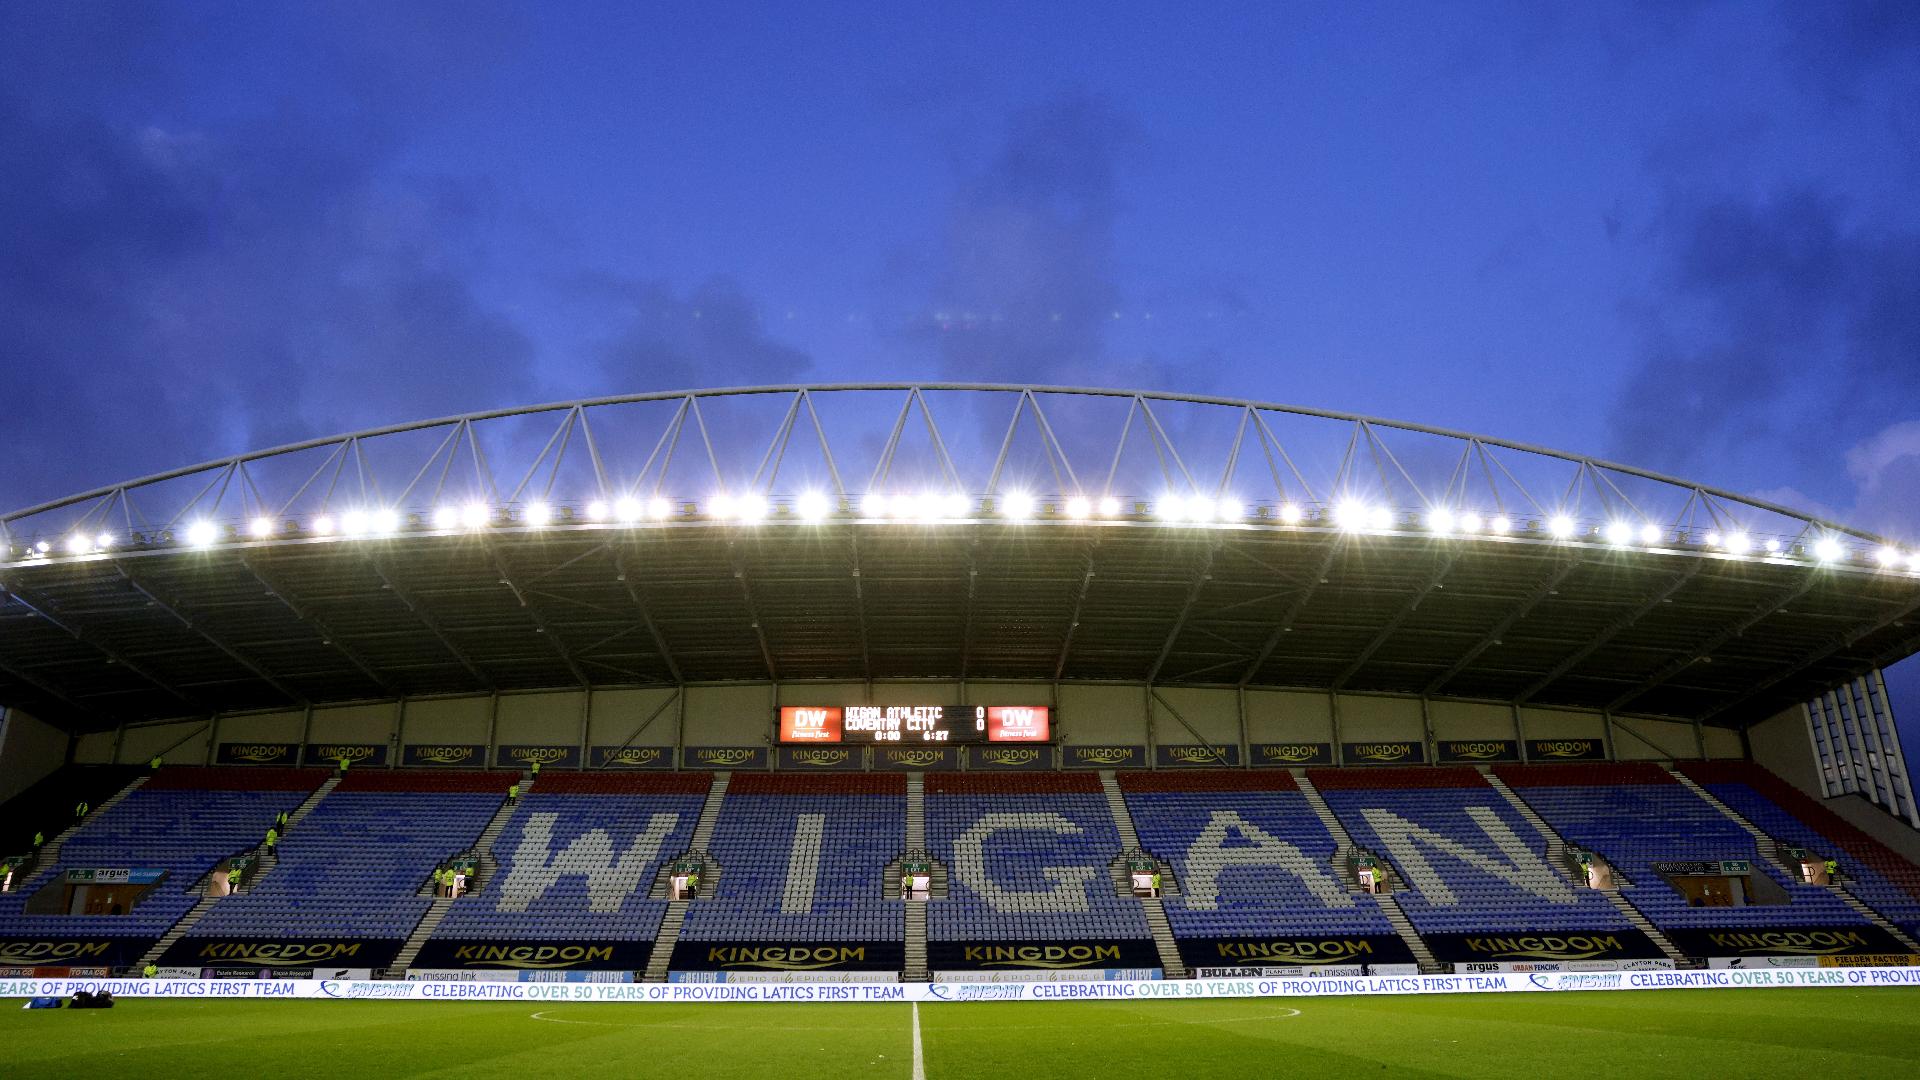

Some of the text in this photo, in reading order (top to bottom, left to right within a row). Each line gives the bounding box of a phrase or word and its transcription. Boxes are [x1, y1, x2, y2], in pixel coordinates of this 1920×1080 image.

[845, 707, 985, 718] WIGAN ATHLETIC 0
[795, 710, 827, 727] DW
[1001, 710, 1033, 726] DW
[845, 718, 985, 730] COVENTRY CITY 0
[875, 731, 949, 741] 0:00 6:27
[231, 746, 287, 756] KINGDOM
[318, 746, 374, 757] KINGDOM
[1263, 746, 1319, 756] KINGDOM
[1355, 745, 1411, 755] KINGDOM
[1450, 743, 1506, 753] KINGDOM
[1537, 742, 1592, 751] KINGDOM
[416, 747, 472, 758] KINGDOM
[511, 748, 567, 758] KINGDOM
[697, 749, 755, 759] KINGDOM
[792, 750, 849, 760] KINGDOM
[887, 750, 944, 760] KINGDOM
[982, 749, 1039, 759] KINGDOM
[1076, 748, 1133, 758] KINGDOM
[98, 869, 129, 878] argus
[1465, 936, 1623, 951] KINGDOM
[1708, 932, 1868, 947] KINGDOM
[200, 943, 362, 957] KINGDOM
[454, 946, 614, 960] KINGDOM
[965, 946, 1121, 960] KINGDOM
[1217, 940, 1373, 956] KINGDOM
[708, 947, 865, 961] KINGDOM
[1467, 962, 1499, 972] argus
[1534, 963, 1560, 971] FENCING
[1623, 960, 1652, 969] CLAYTON
[1655, 960, 1671, 969] PARK
[423, 971, 459, 980] missing
[461, 971, 477, 980] link
[1201, 968, 1263, 977] BULLEN
[1324, 967, 1359, 976] missing
[1631, 972, 1729, 986] CELEBRATING
[1732, 971, 1773, 985] OVER
[1777, 971, 1795, 984] 50
[1797, 970, 1845, 984] YEARS
[1848, 970, 1866, 983] OF
[41, 982, 62, 995] OF
[65, 982, 150, 995] PROVIDING
[154, 982, 206, 995] LATICS
[209, 982, 251, 995] FIRST
[254, 982, 295, 995] TEAM
[421, 984, 905, 999] CELEBRATING OVER 50 YEARS OF PROVIDING LATICS FIRST TEAM
[1033, 977, 1507, 998] CELEBRATING OVER 50 YEARS OF PROVIDING LATICS FIRST TEAM
